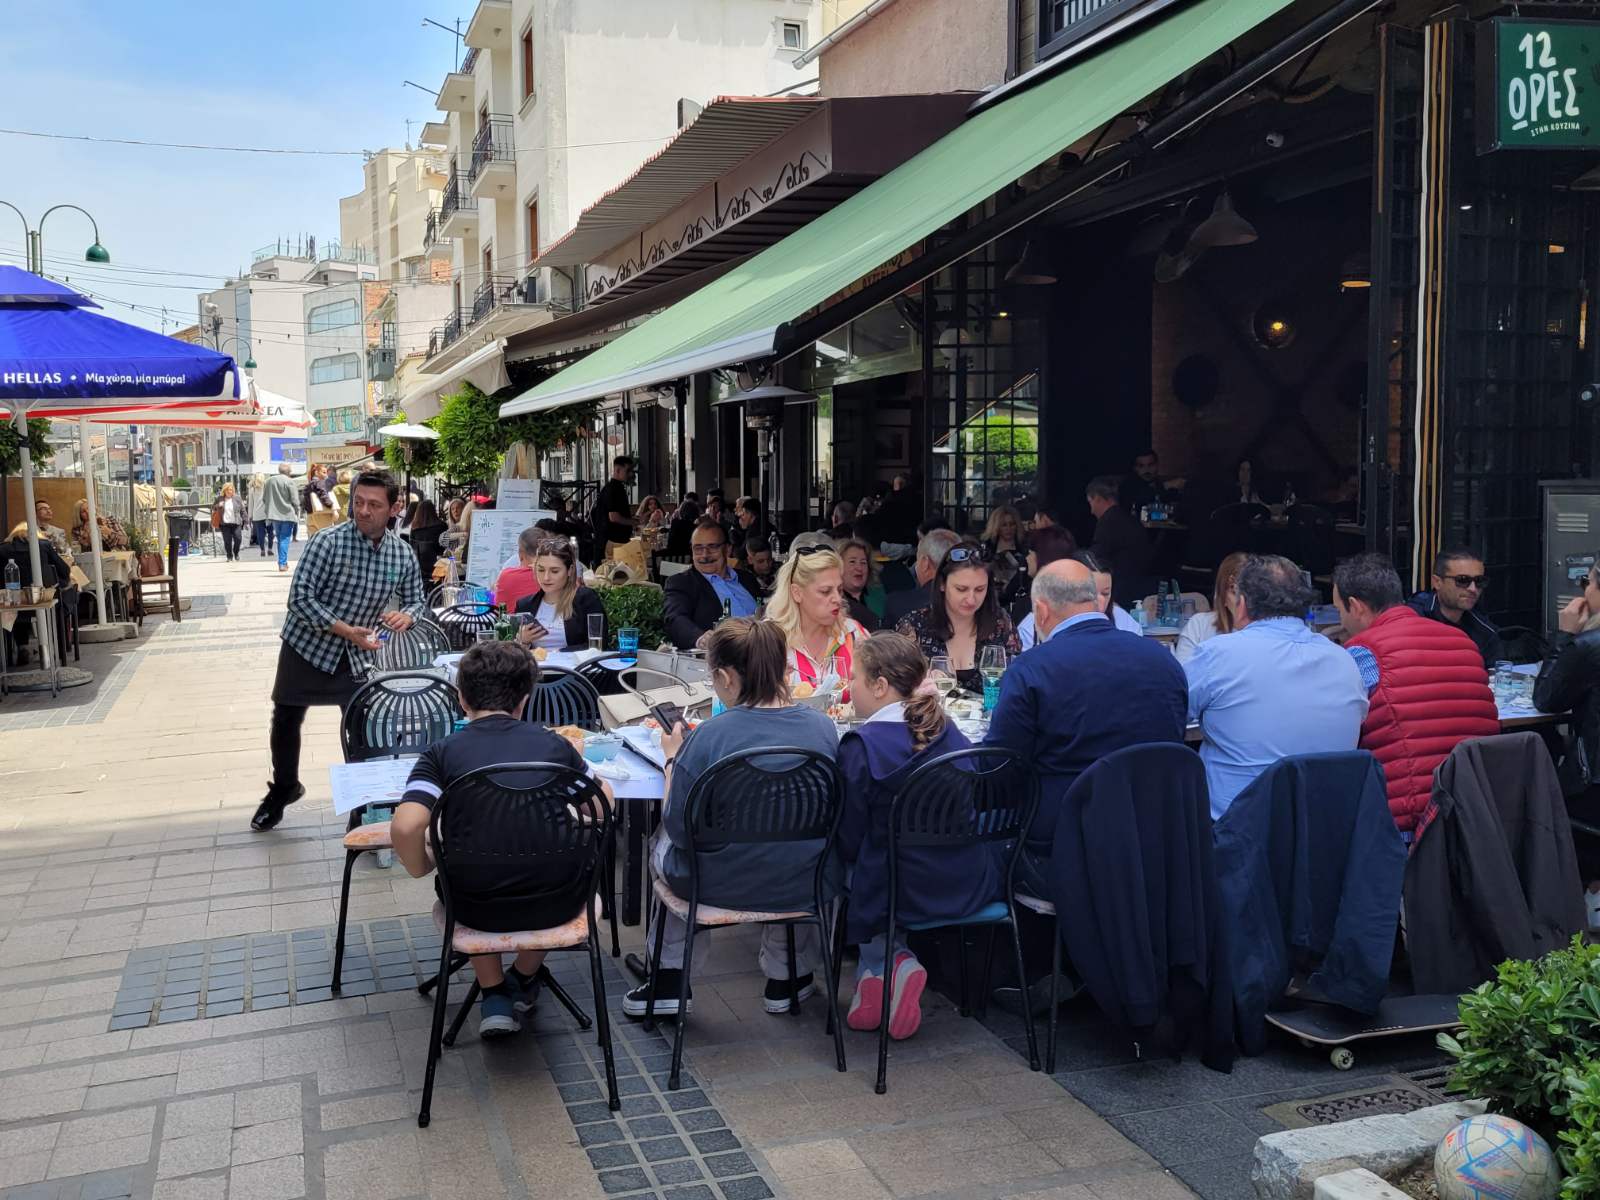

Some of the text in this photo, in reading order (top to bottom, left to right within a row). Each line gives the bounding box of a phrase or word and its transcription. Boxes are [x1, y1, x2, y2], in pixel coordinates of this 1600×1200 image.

[1519, 31, 1557, 69] 12
[1550, 122, 1580, 131] ΚΟΥΖΙΝΑ
[4, 372, 62, 384] HELLAS
[86, 373, 186, 386] Μία χώρα, μία μπύρα!
